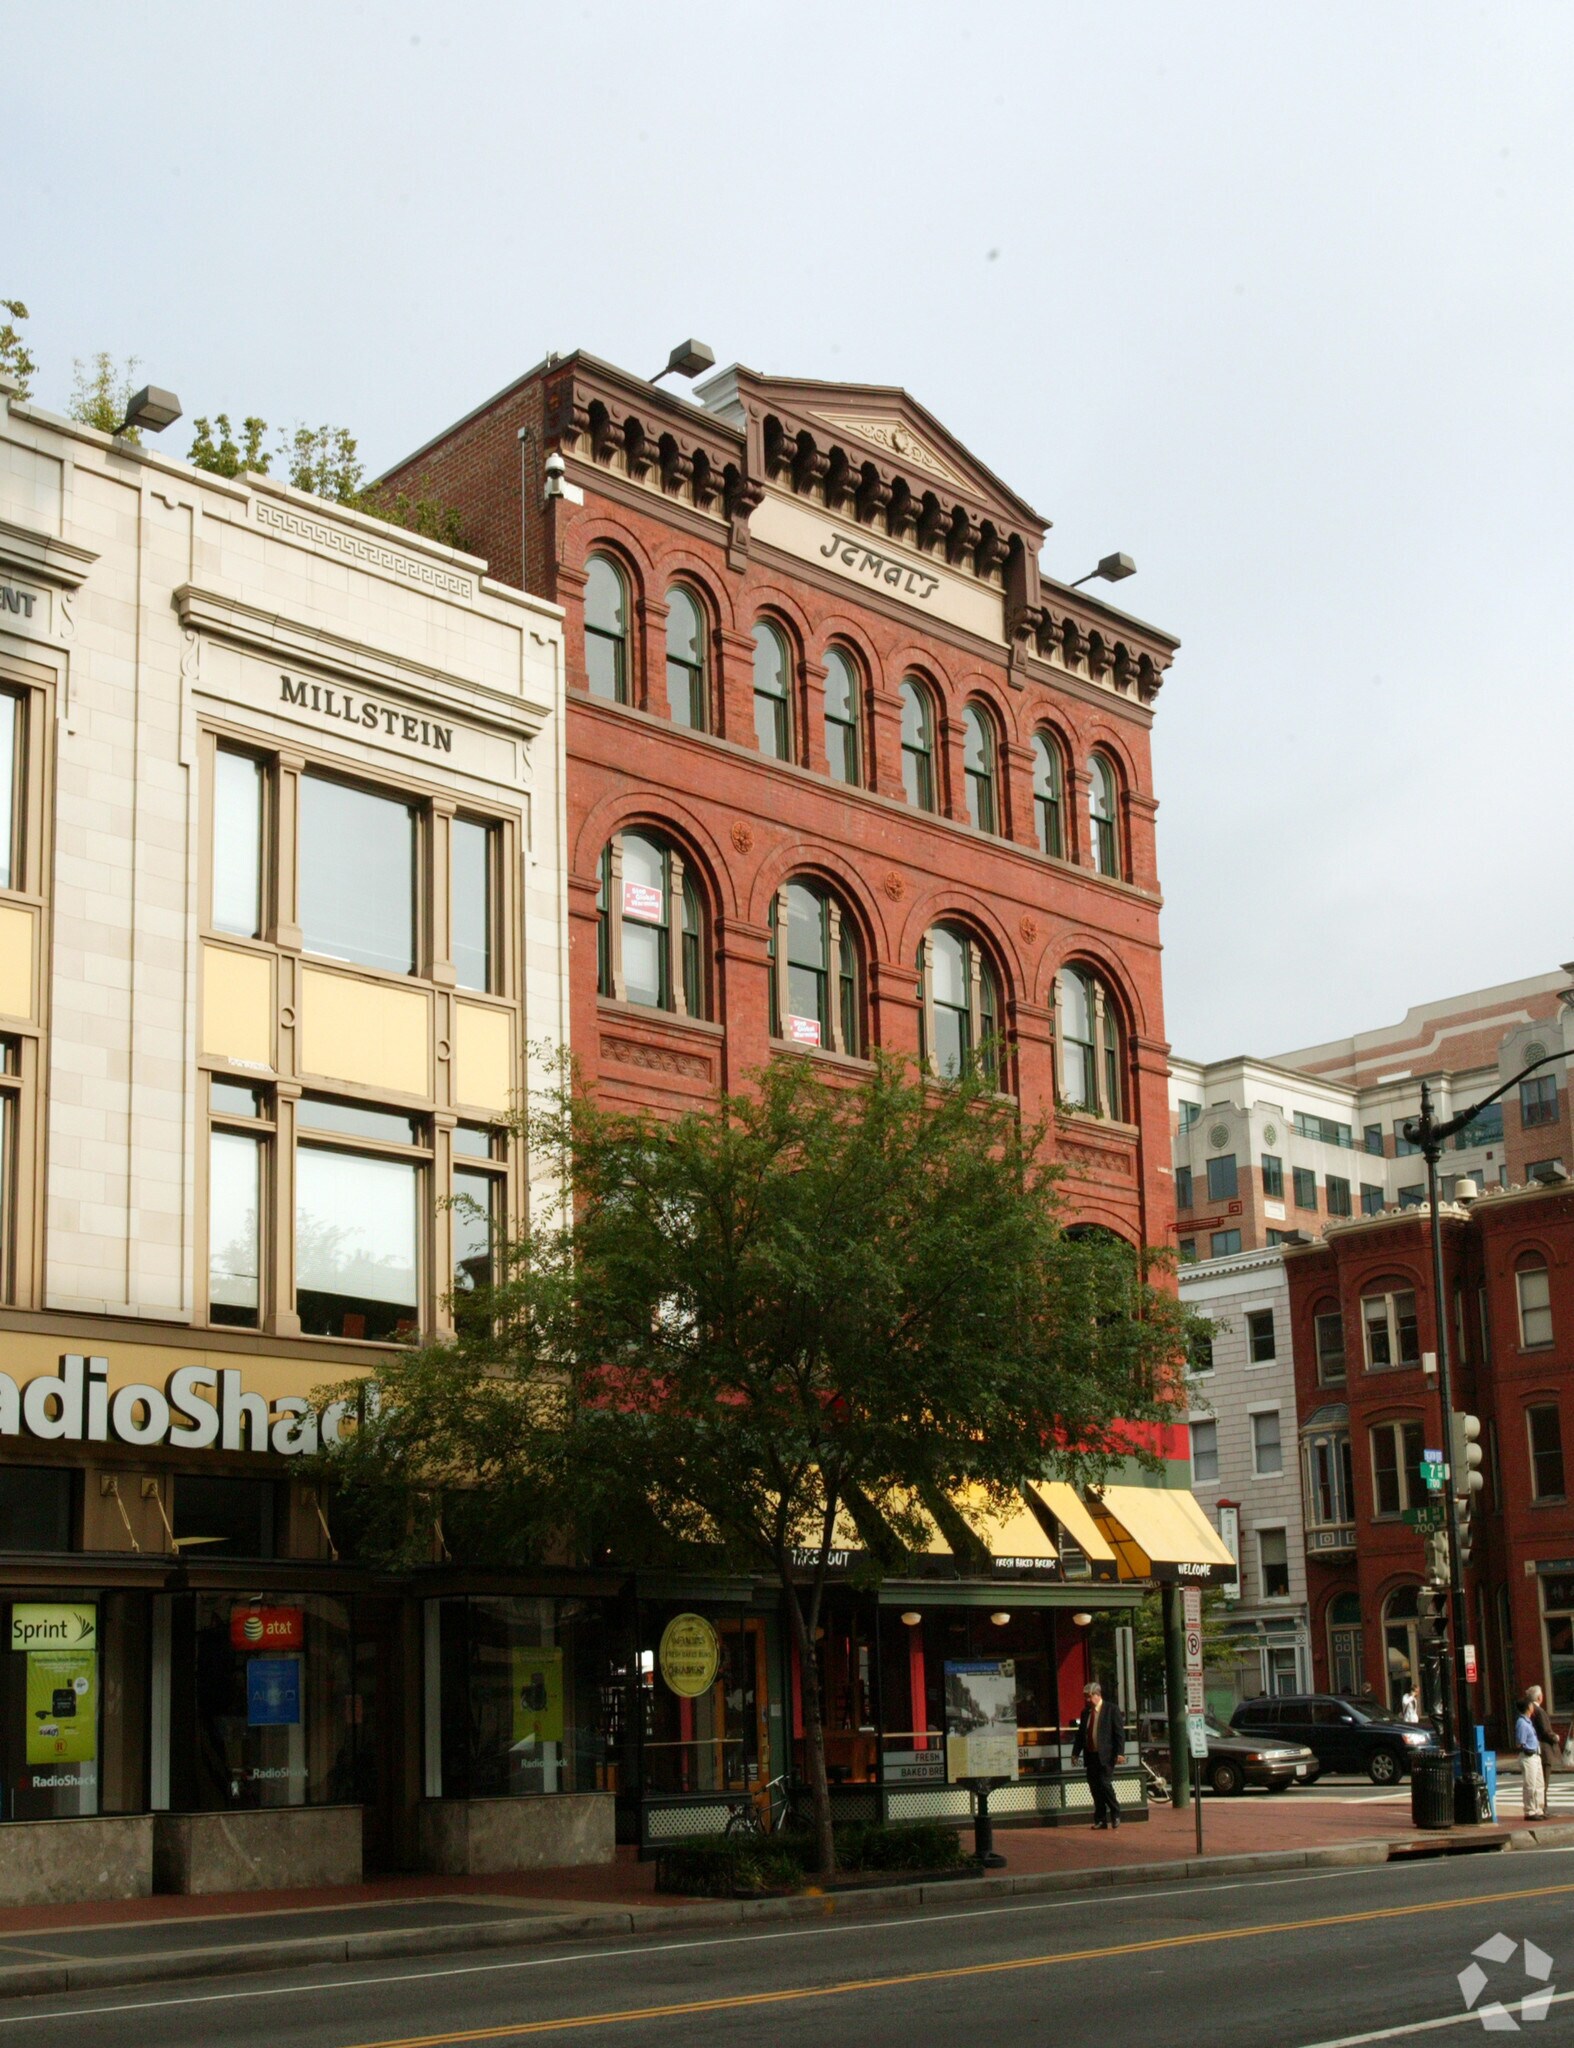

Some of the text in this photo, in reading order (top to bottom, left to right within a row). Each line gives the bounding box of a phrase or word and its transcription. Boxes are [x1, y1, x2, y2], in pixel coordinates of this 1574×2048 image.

[0, 585, 37, 618] NT
[280, 675, 454, 753] MILLSTEIN
[0, 1353, 388, 1457] dioShac
[1429, 1464, 1436, 1478] 7
[1429, 1479, 1441, 1488] 700
[1417, 1509, 1428, 1523] H
[1413, 1522, 1435, 1534] 700
[827, 1550, 850, 1568] OUT
[995, 1557, 1014, 1568] FRESH
[1015, 1557, 1034, 1568] BAKED
[1177, 1563, 1212, 1577] WELCOME
[13, 1619, 68, 1643] Sprint
[266, 1620, 292, 1635] at&t
[521, 1757, 569, 1769] Radioack
[915, 1752, 940, 1762] FRESH
[901, 1767, 927, 1777] BAKED
[32, 1774, 97, 1788] RadioShack
